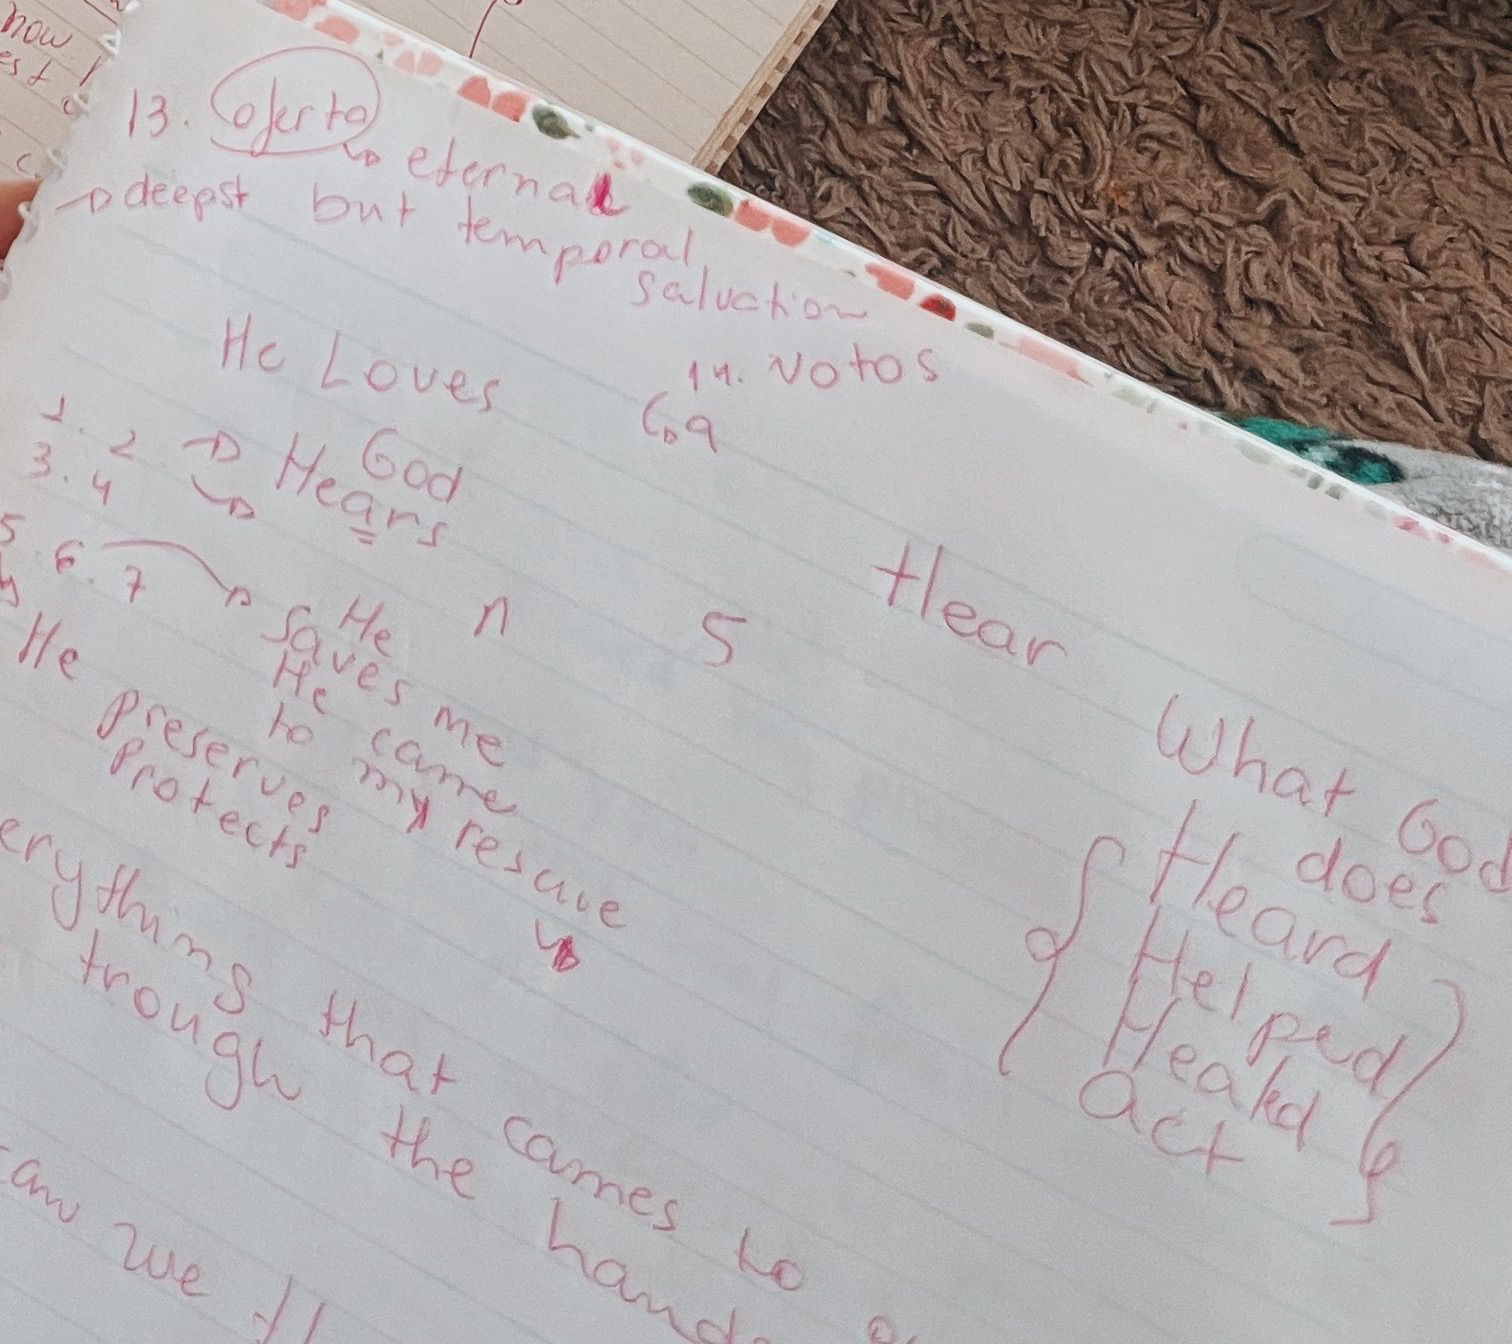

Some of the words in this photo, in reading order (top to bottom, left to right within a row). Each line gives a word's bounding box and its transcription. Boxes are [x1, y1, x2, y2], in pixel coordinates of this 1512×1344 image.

[312, 182, 417, 228] but
[221, 312, 286, 373] He
[361, 427, 462, 503] God
[872, 542, 1067, 666] Hear
[19, 612, 79, 681] He
[1297, 837, 1448, 924] does
[381, 1103, 475, 1200] the
